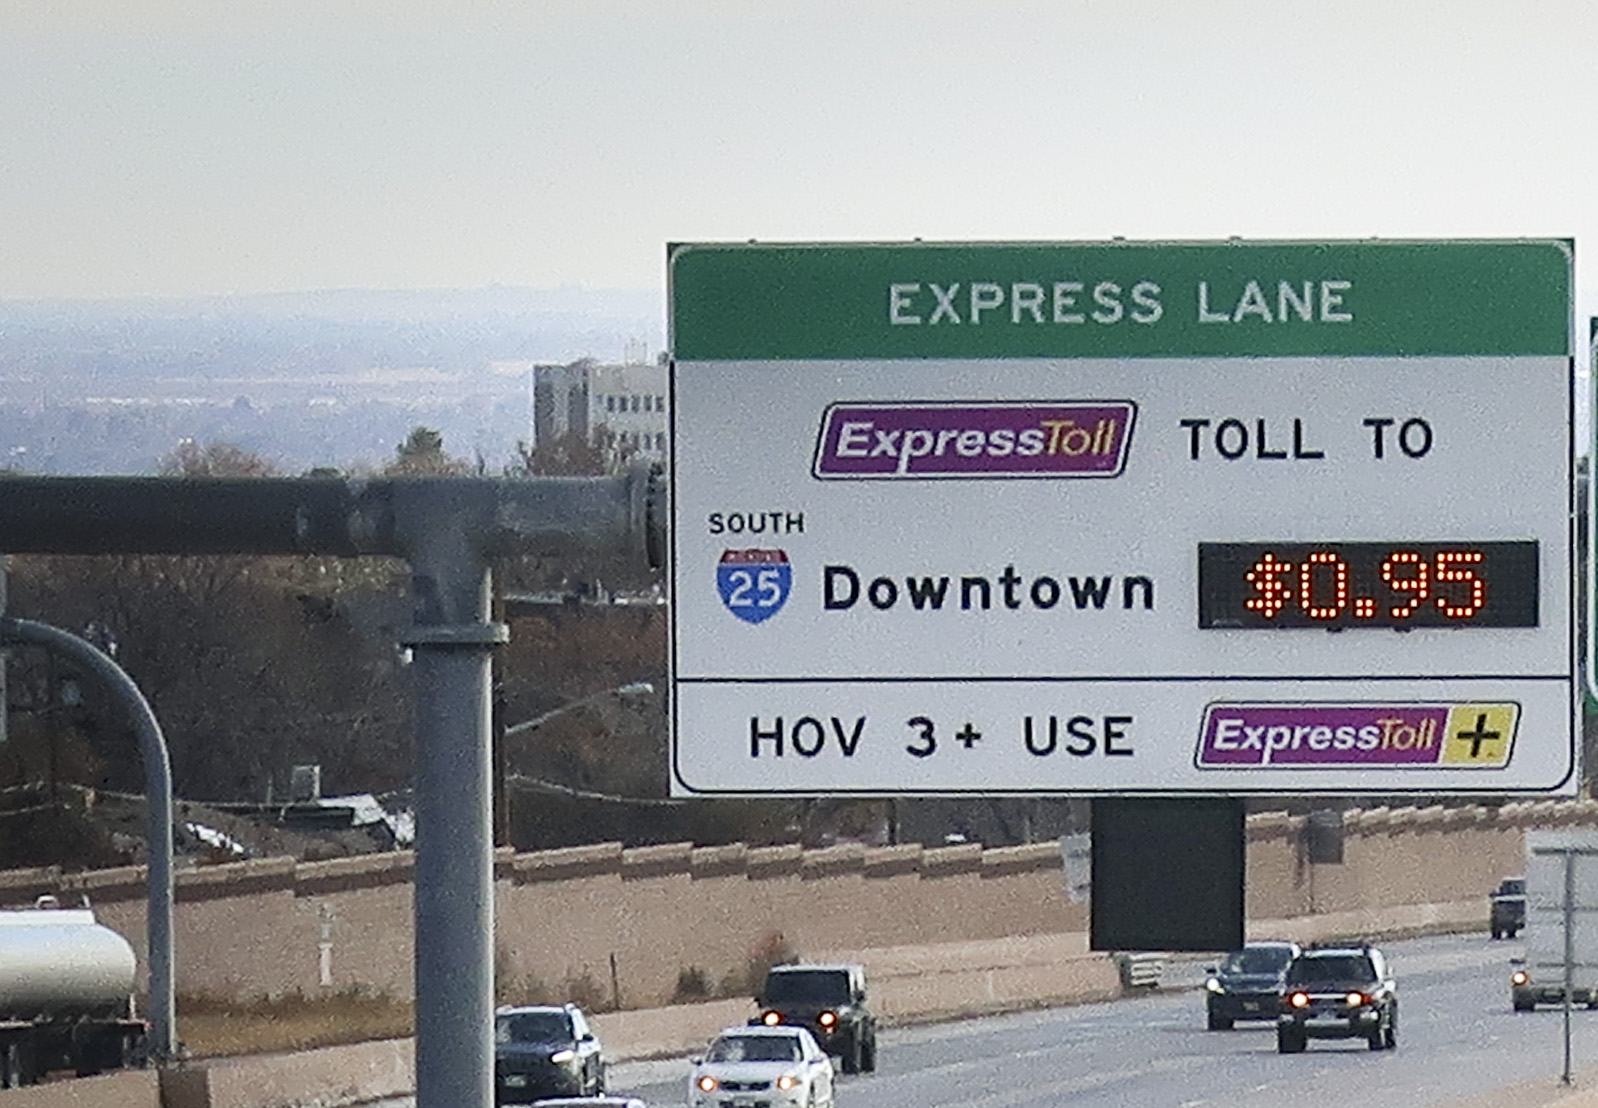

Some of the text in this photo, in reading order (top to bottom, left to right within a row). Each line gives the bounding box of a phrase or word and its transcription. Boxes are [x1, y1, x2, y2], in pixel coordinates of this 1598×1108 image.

[889, 281, 1355, 325] EXPRESS LANE
[836, 408, 1117, 474] ExpressToll
[1180, 418, 1435, 461] TOLL TO
[708, 512, 805, 535] SOUTH
[728, 570, 782, 608] 25
[823, 564, 1156, 612] Downtown
[1246, 553, 1485, 620] $0.95
[749, 716, 868, 760] HOV
[1023, 715, 1136, 759] USE
[1212, 717, 1437, 765] ExpressToll
